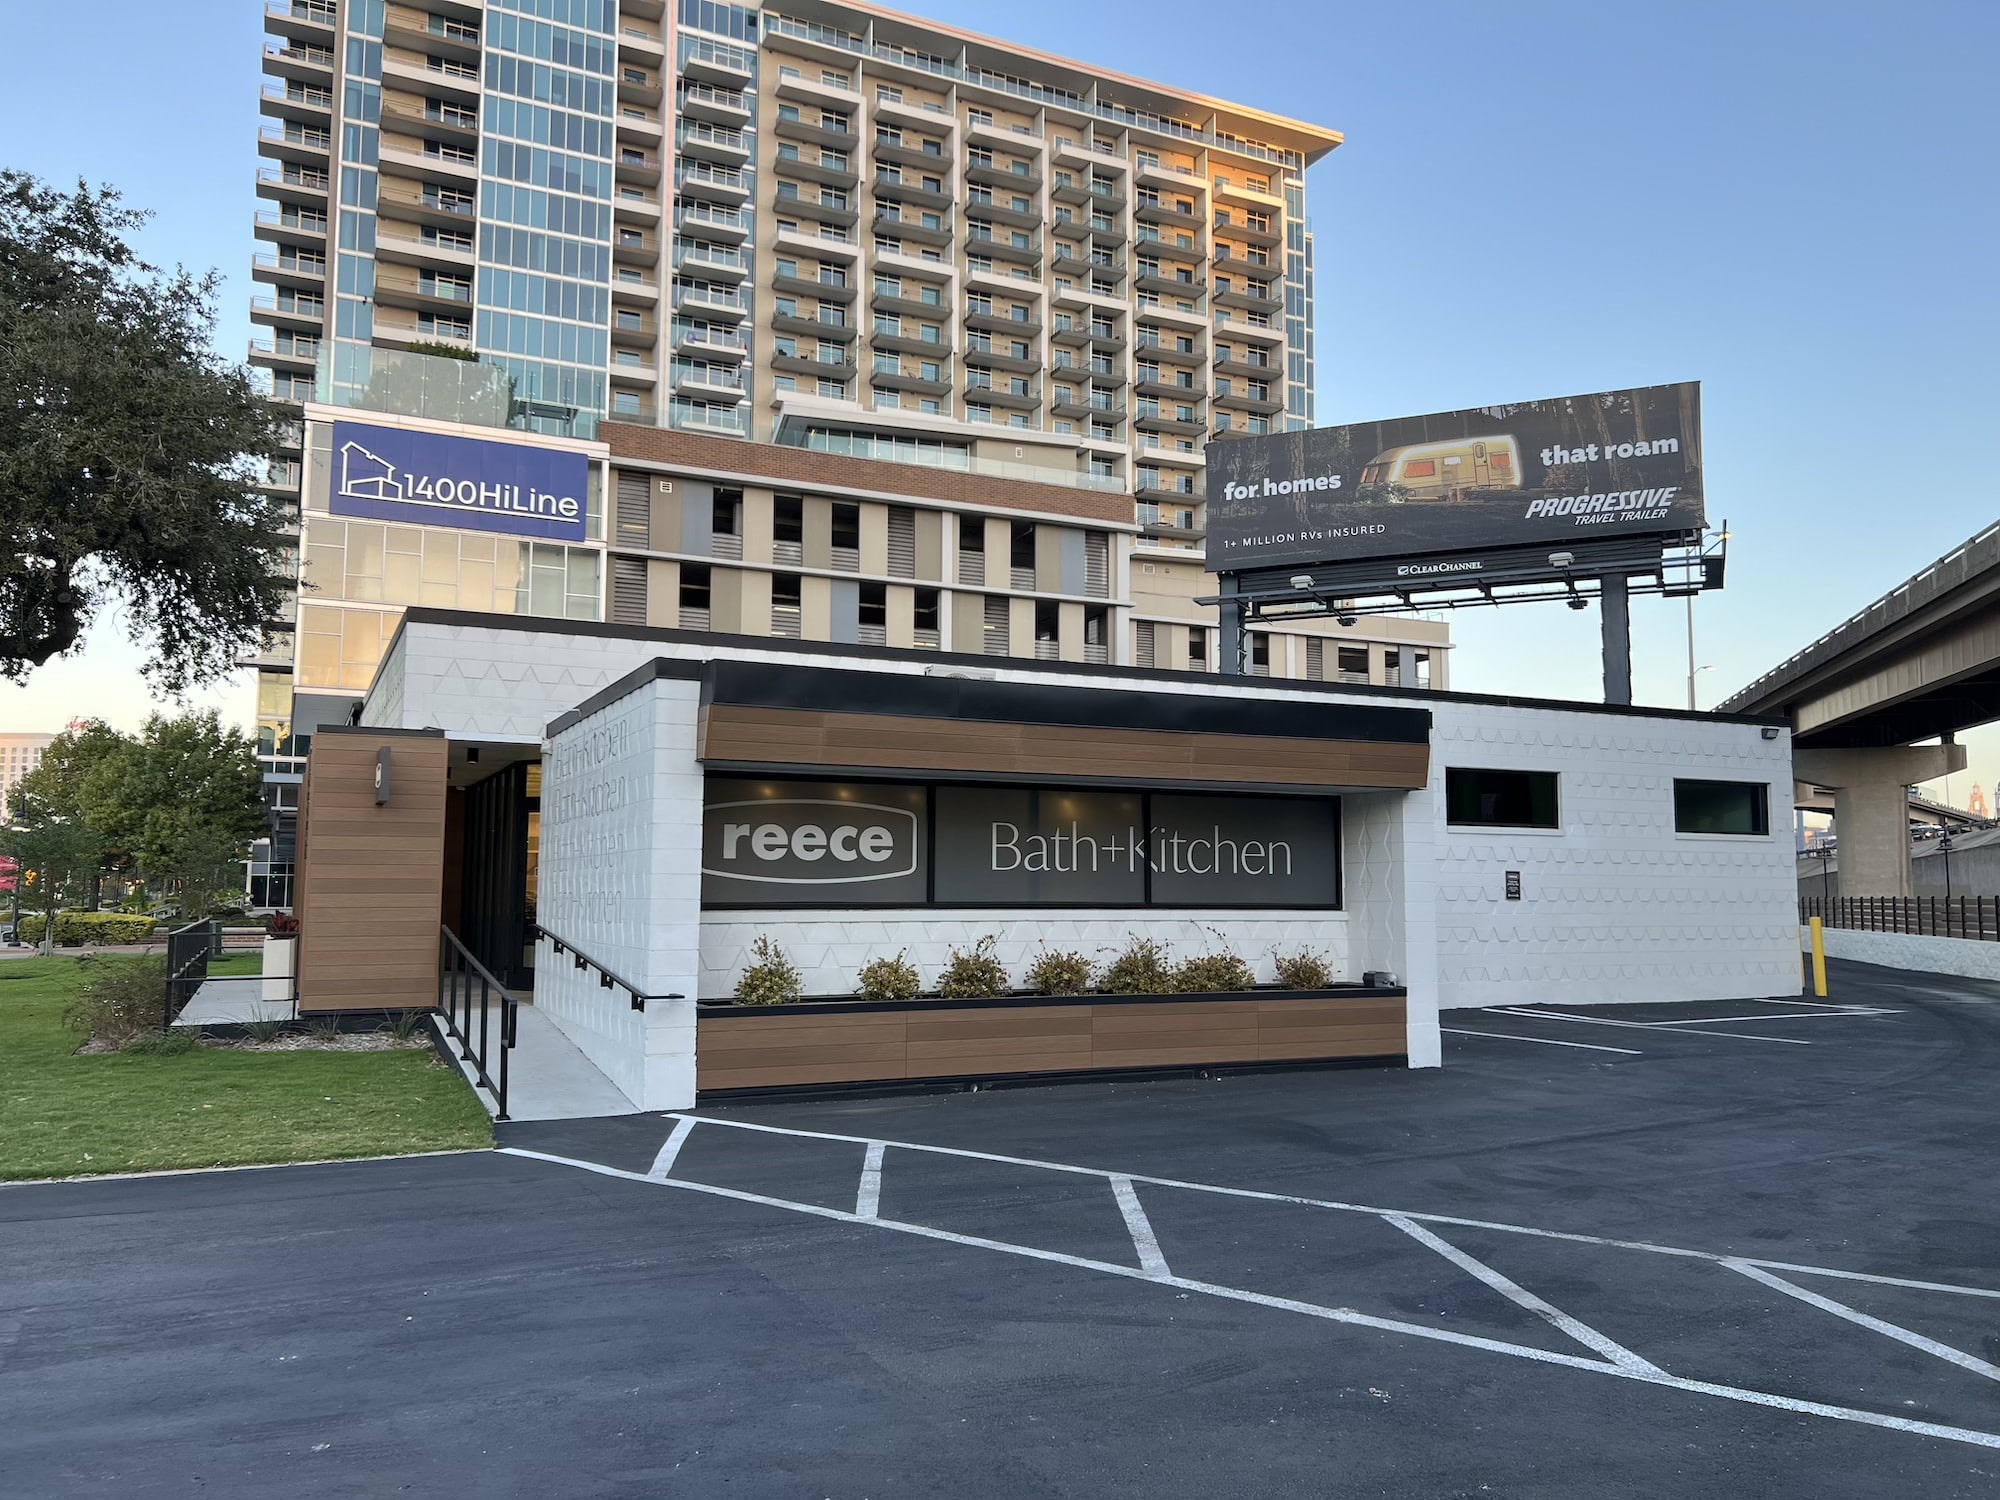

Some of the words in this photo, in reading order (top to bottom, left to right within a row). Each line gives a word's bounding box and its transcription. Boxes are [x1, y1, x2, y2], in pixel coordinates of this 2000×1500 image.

[1540, 443, 1599, 467] that
[1604, 437, 1679, 460] roam
[403, 473, 579, 518] 1400HiLine
[1224, 481, 1259, 500] for
[1263, 475, 1342, 497] homes
[1524, 486, 1677, 519] PROGRESSIVE
[1574, 512, 1615, 526] TRAVEL
[1619, 508, 1668, 522] TRAILER
[1223, 539, 1237, 549] 1+
[1242, 532, 1296, 547] MILLION
[1300, 530, 1323, 541] RVs
[1328, 524, 1387, 539] INSURED
[722, 822, 894, 863] reece
